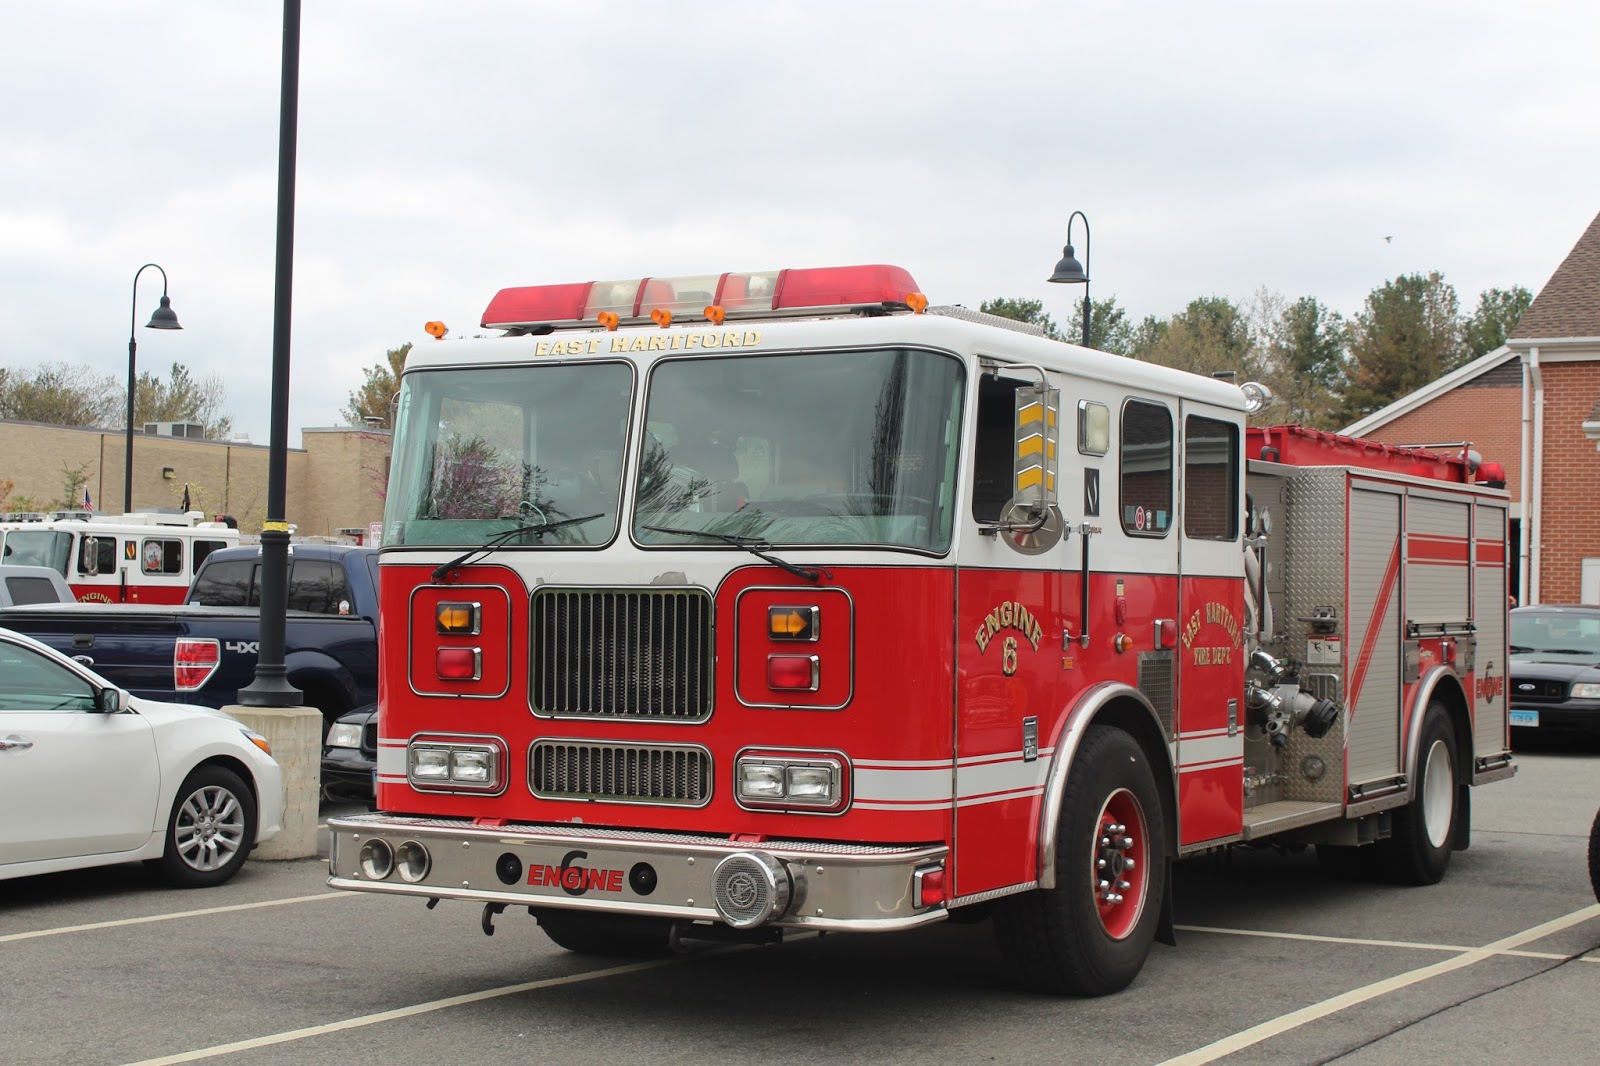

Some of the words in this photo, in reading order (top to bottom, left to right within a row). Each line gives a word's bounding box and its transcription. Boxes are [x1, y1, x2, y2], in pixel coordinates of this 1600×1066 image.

[535, 338, 601, 356] EAST
[610, 330, 762, 353] HARTFORD
[975, 600, 1043, 654] ENGINE
[1181, 609, 1201, 651] EAST
[1205, 602, 1241, 650] HARTFORD
[1002, 636, 1018, 677] 6
[1193, 647, 1210, 666] FIRE
[1475, 675, 1504, 699] ENGINE
[527, 863, 625, 893] ENGINE
[560, 850, 589, 896] 6
